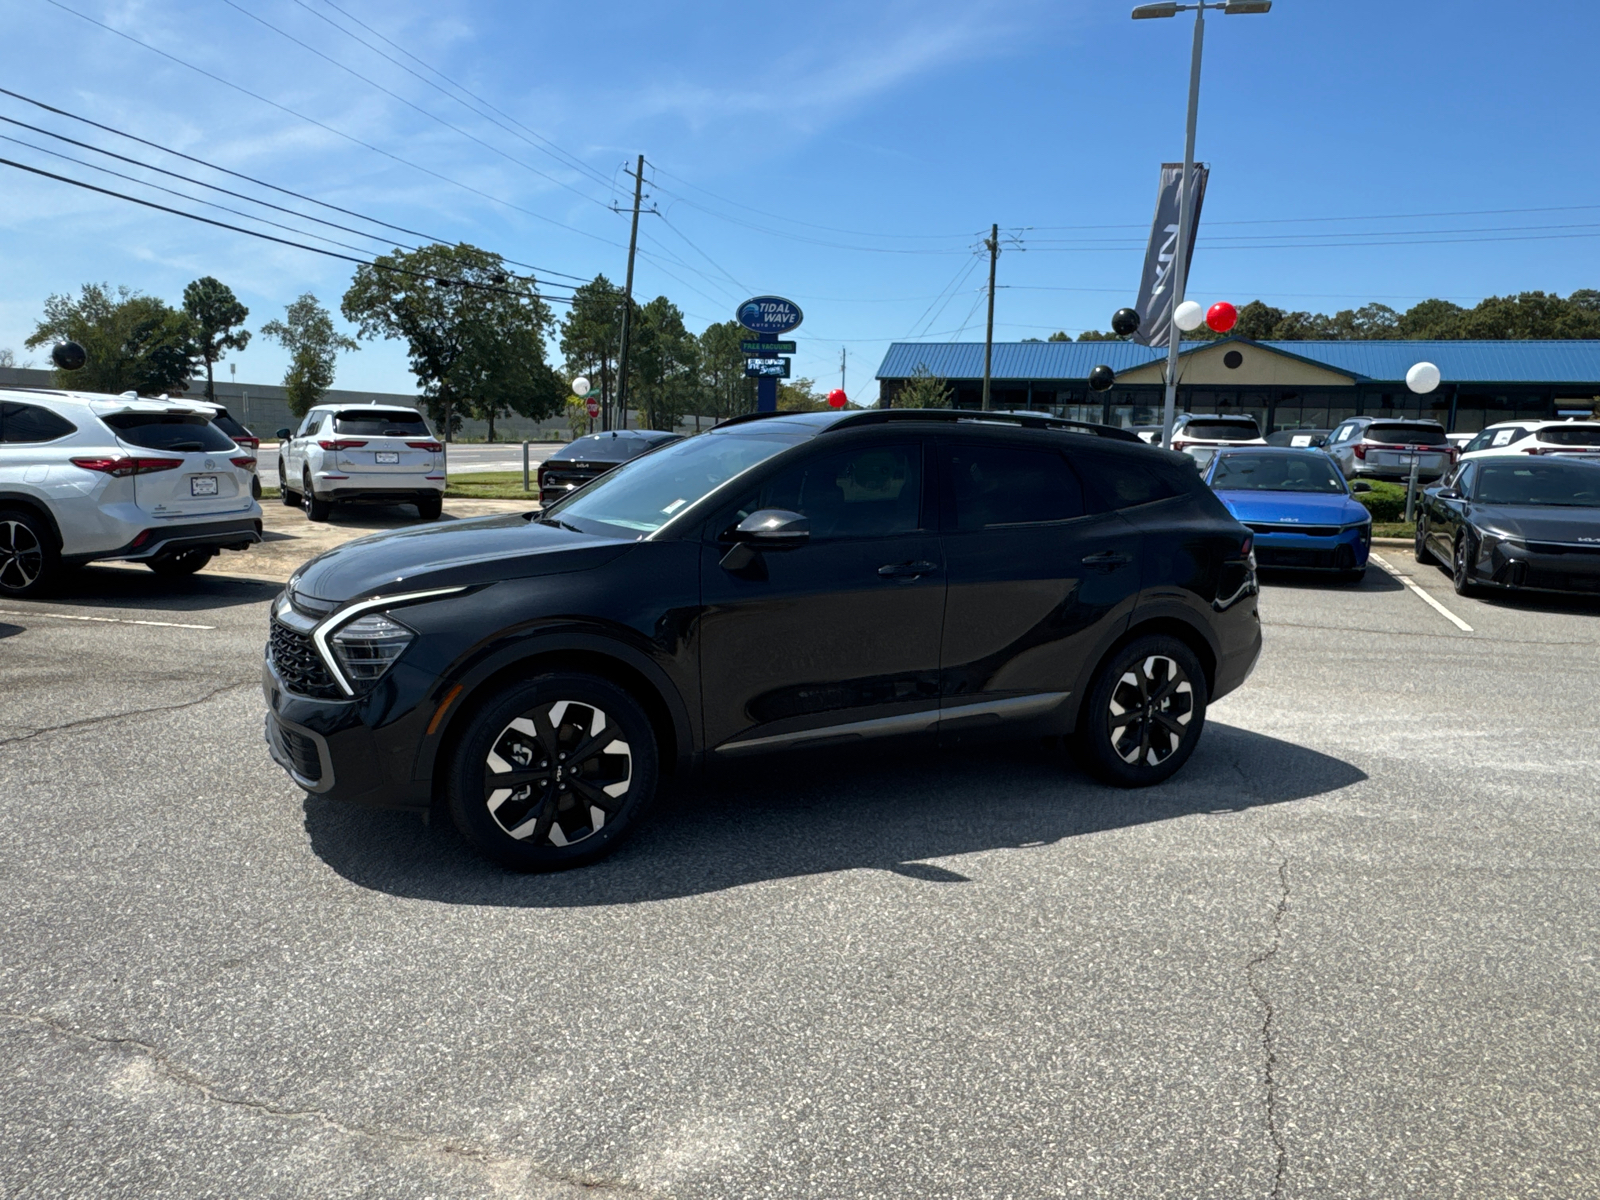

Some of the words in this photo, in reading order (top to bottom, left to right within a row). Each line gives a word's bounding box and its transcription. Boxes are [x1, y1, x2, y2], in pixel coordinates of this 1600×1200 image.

[759, 303, 790, 313] TIDAL
[764, 313, 796, 323] WAVE
[761, 343, 793, 351] VACUUMS
